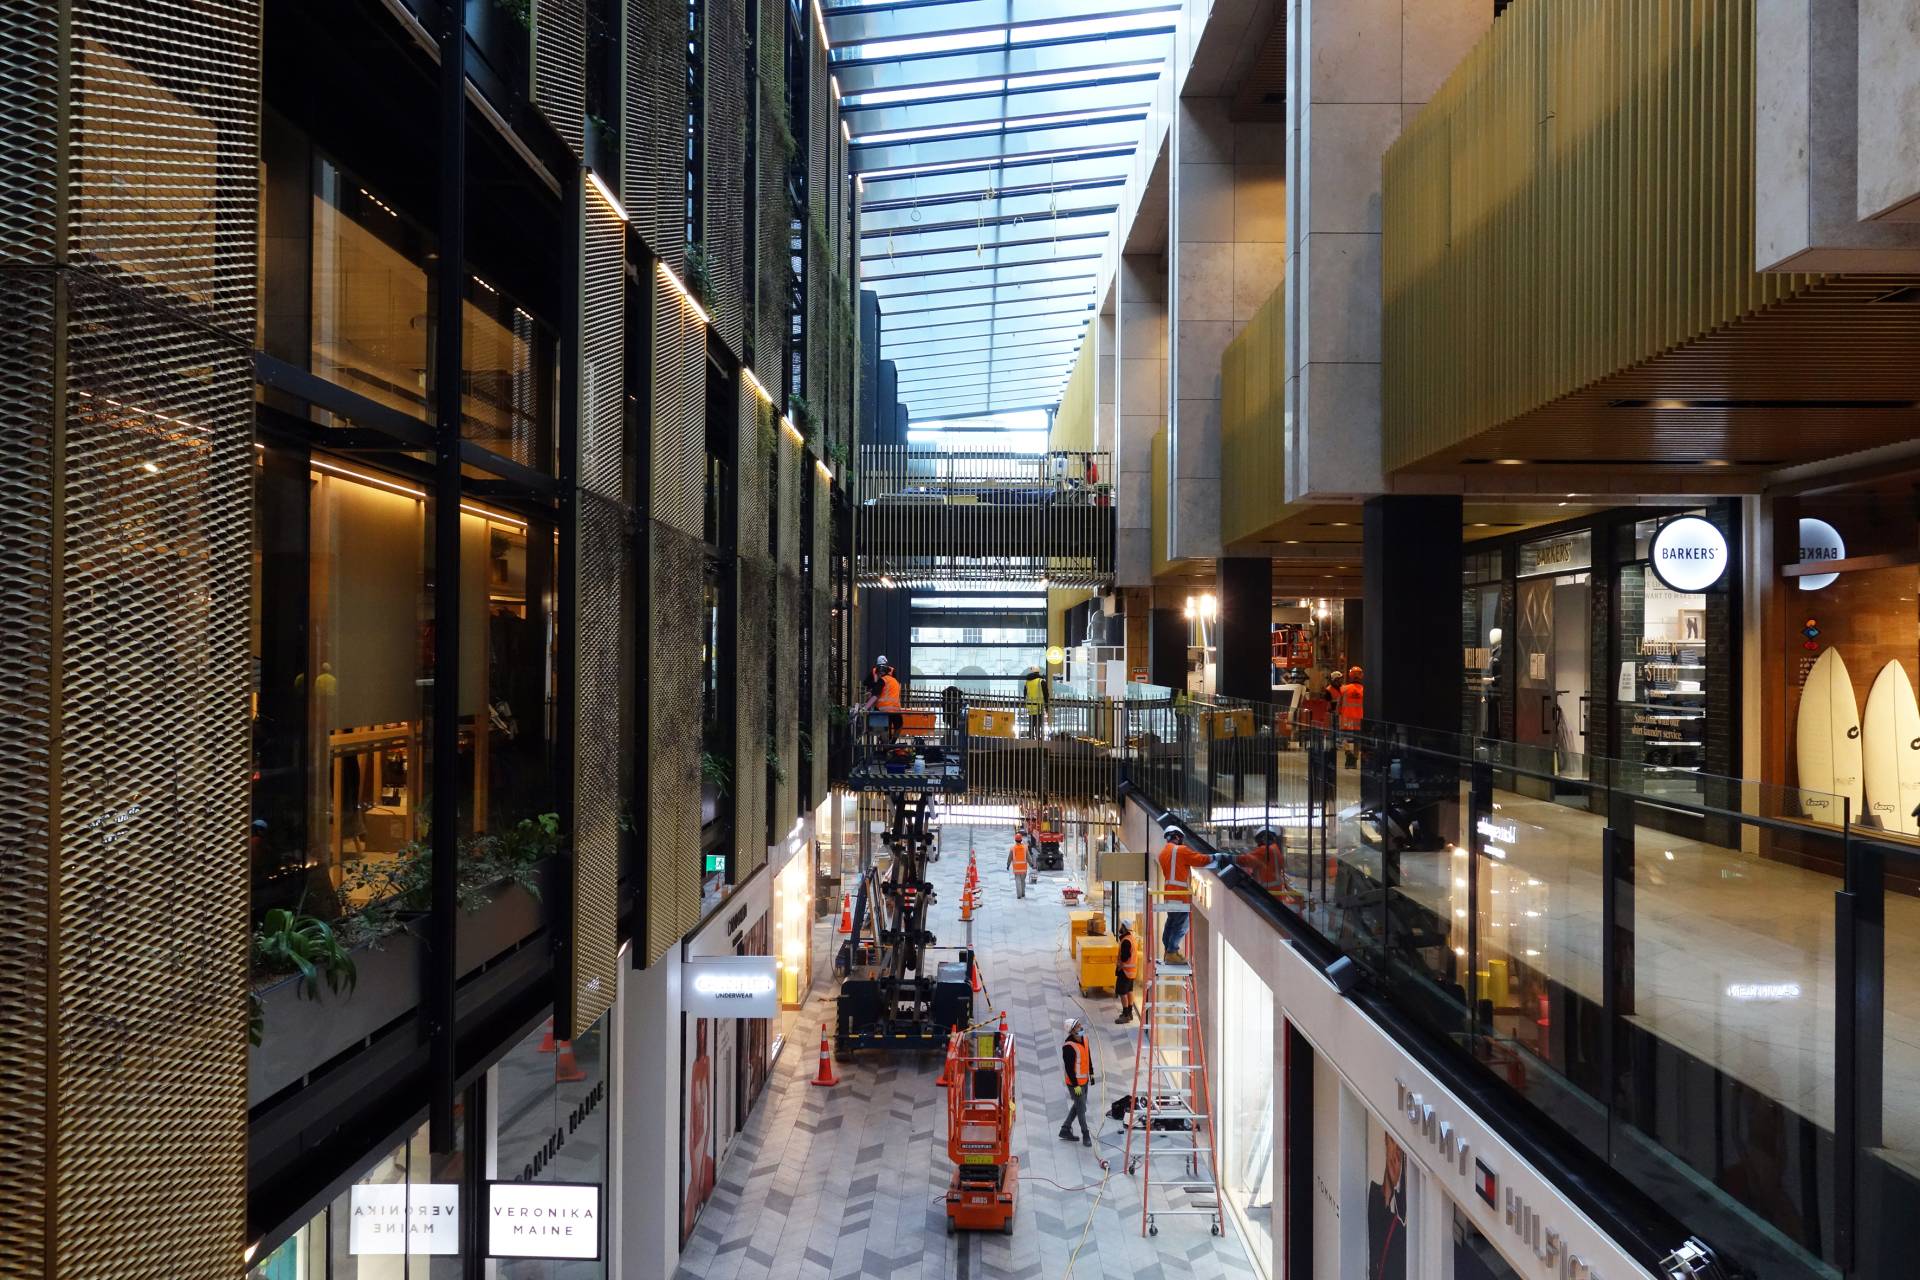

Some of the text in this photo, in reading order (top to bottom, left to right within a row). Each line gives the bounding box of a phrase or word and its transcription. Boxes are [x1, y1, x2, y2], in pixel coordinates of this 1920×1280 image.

[569, 1081, 604, 1135] MAINE
[1395, 1077, 1470, 1177] TOMMY
[494, 1206, 594, 1219] VERONIKA
[513, 1225, 573, 1236] MAINE
